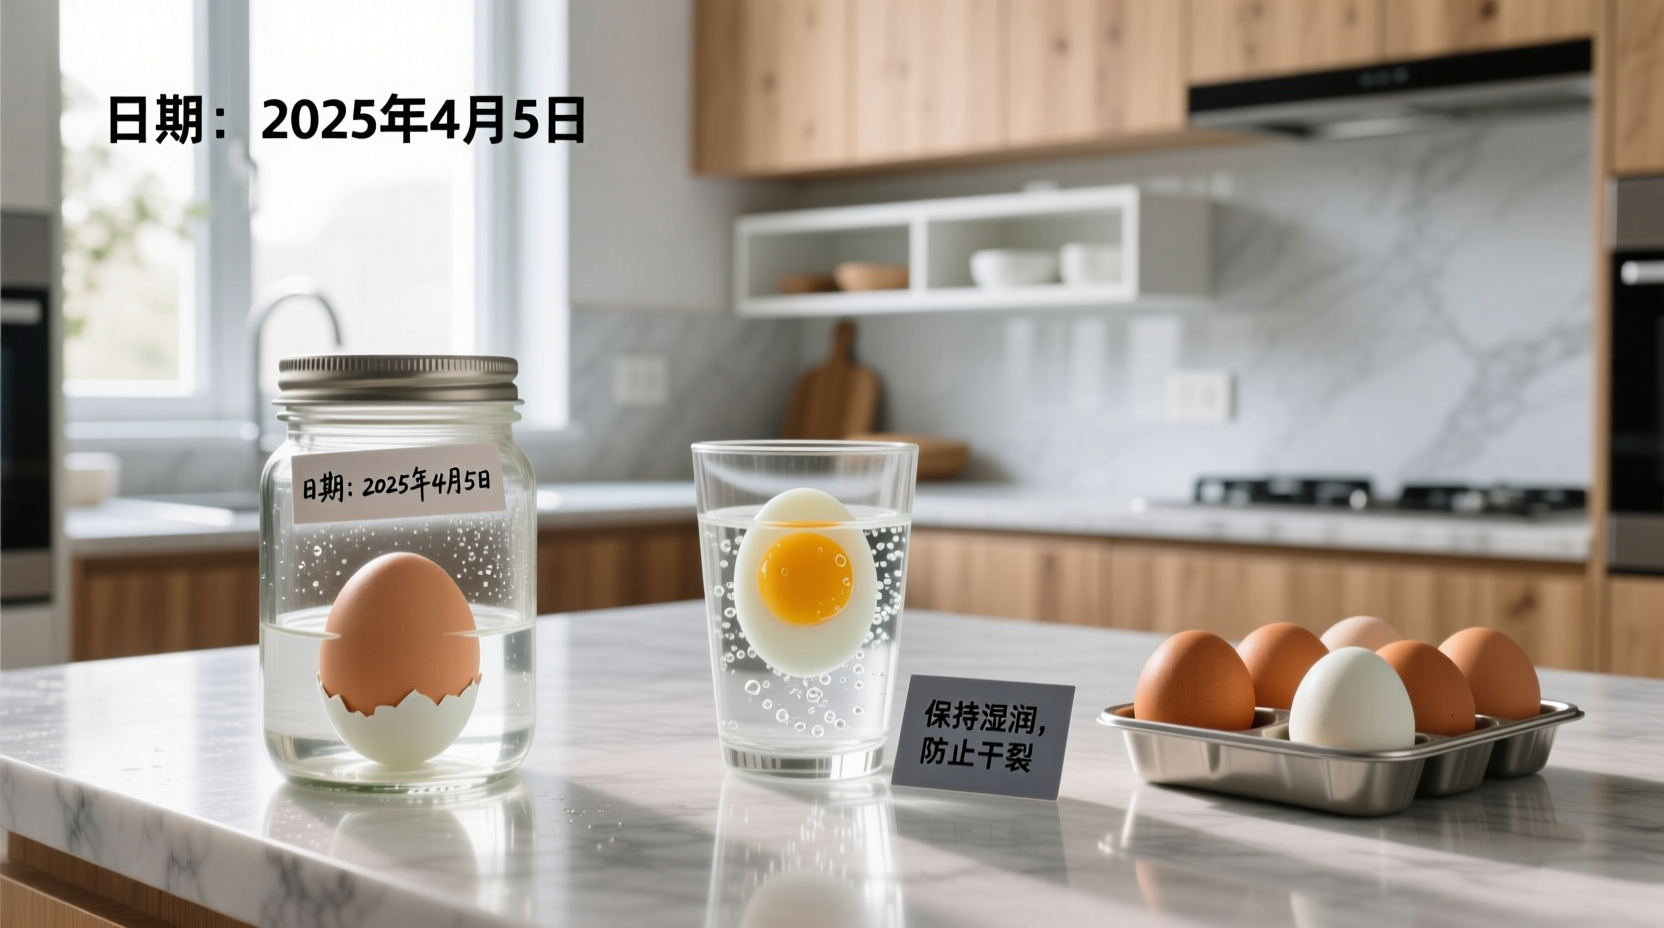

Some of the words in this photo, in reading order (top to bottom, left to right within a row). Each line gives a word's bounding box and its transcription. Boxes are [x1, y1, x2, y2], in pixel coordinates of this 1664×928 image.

[924, 699, 1046, 737] 保持湿润，
[920, 736, 1034, 773] 防止干裂
